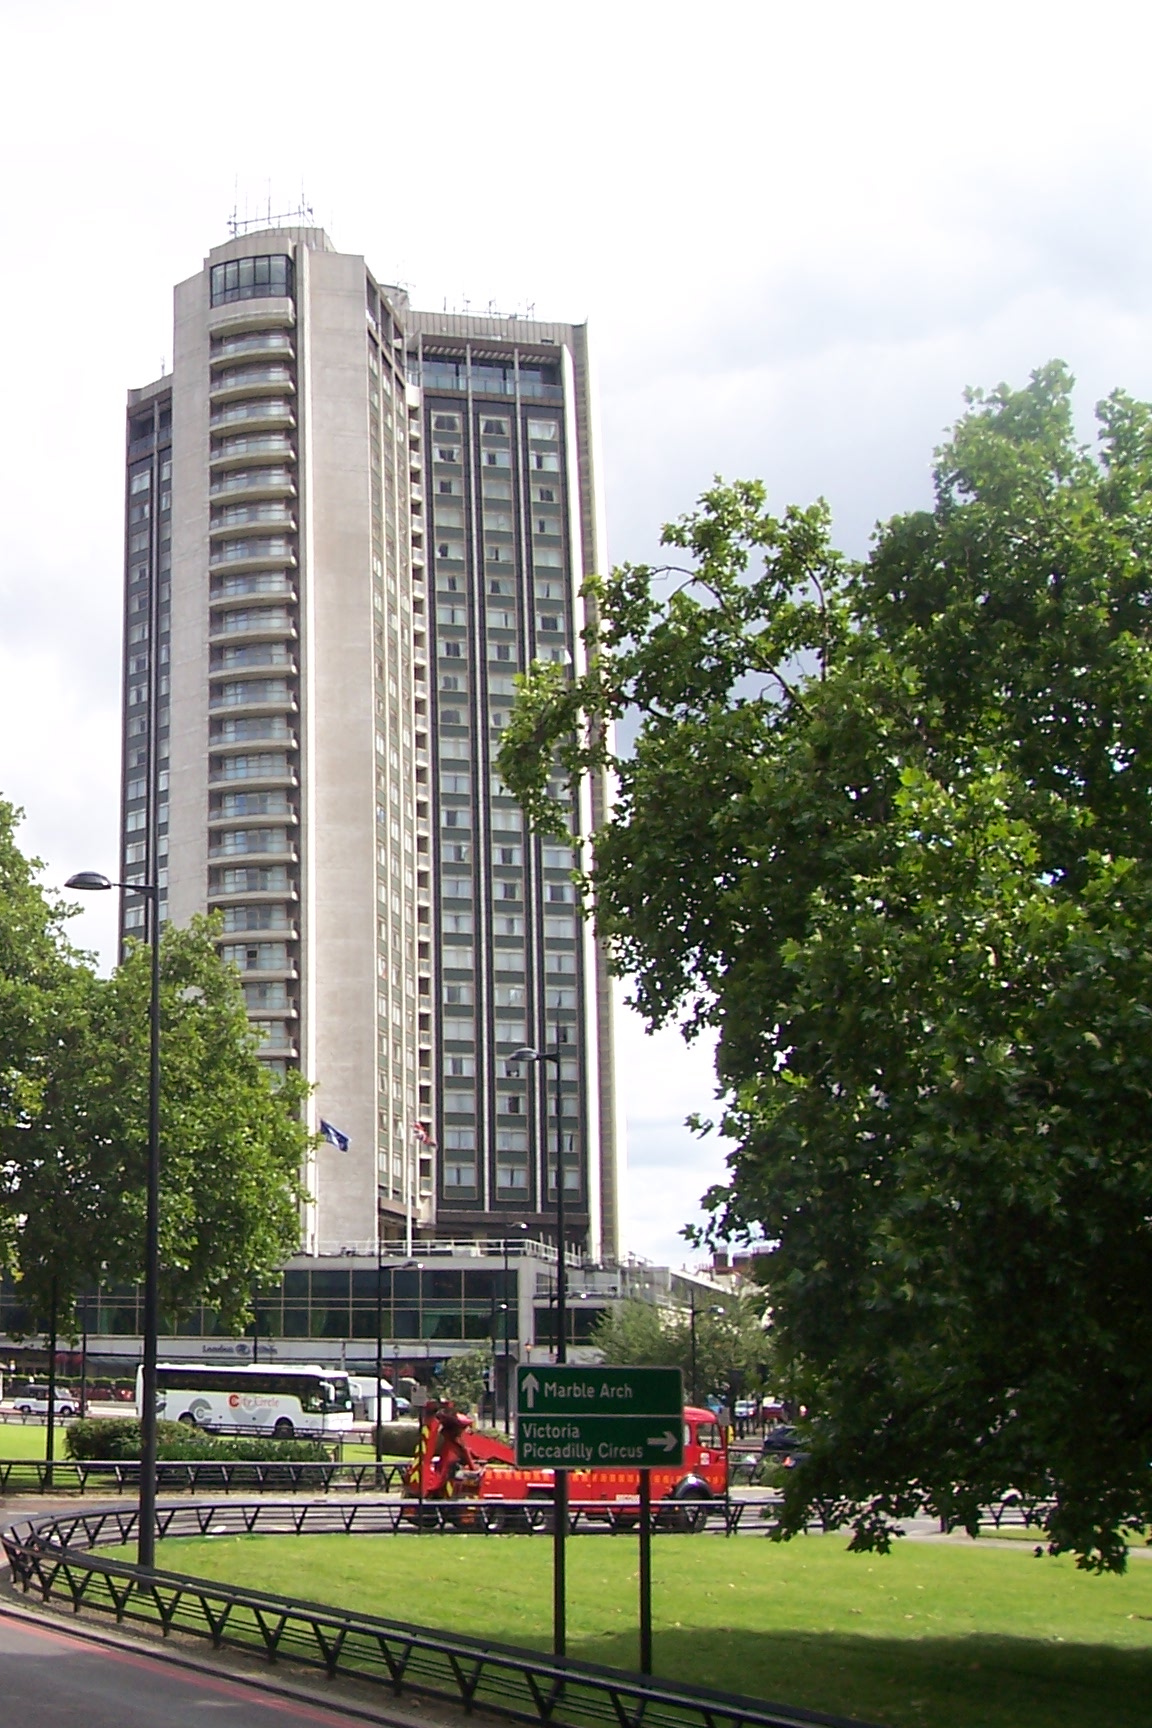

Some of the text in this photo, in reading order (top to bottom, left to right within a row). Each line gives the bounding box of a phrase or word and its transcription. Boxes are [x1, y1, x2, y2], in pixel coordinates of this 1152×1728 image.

[544, 1382, 633, 1399] Marble Arch
[522, 1423, 581, 1439] Victoria
[523, 1443, 644, 1461] Piccadilly Circus
